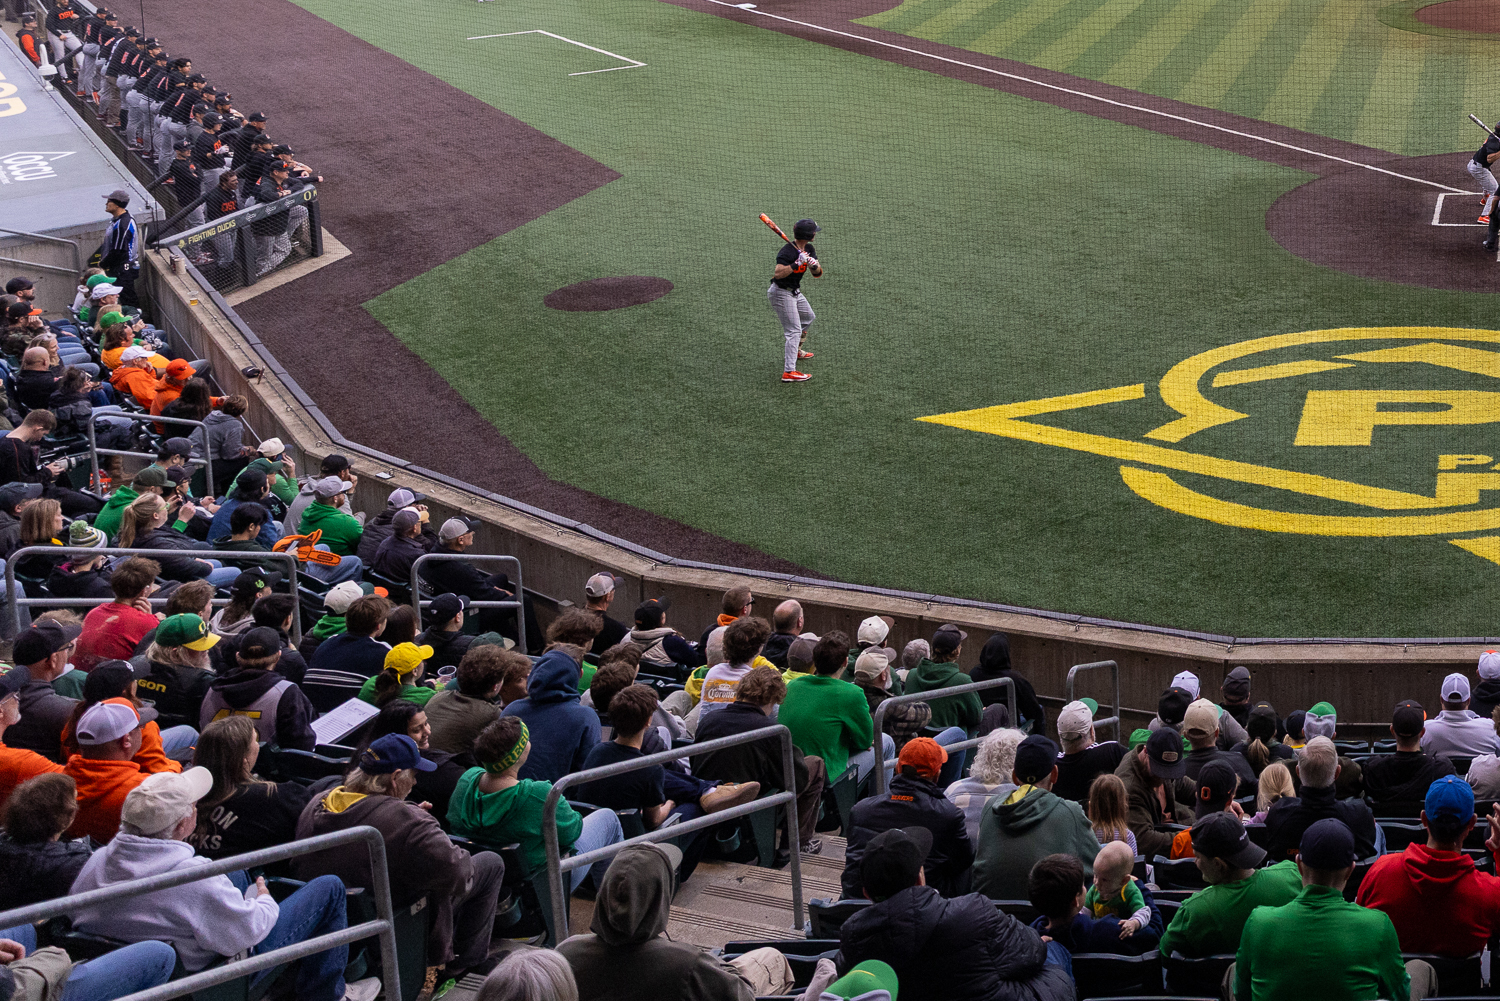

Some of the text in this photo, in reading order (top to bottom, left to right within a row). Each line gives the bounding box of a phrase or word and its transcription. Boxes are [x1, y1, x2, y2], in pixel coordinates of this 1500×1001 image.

[188, 220, 236, 244] FIGHTING DUCKS
[708, 690, 735, 700] Corona
[891, 794, 914, 802] BEAVERS
